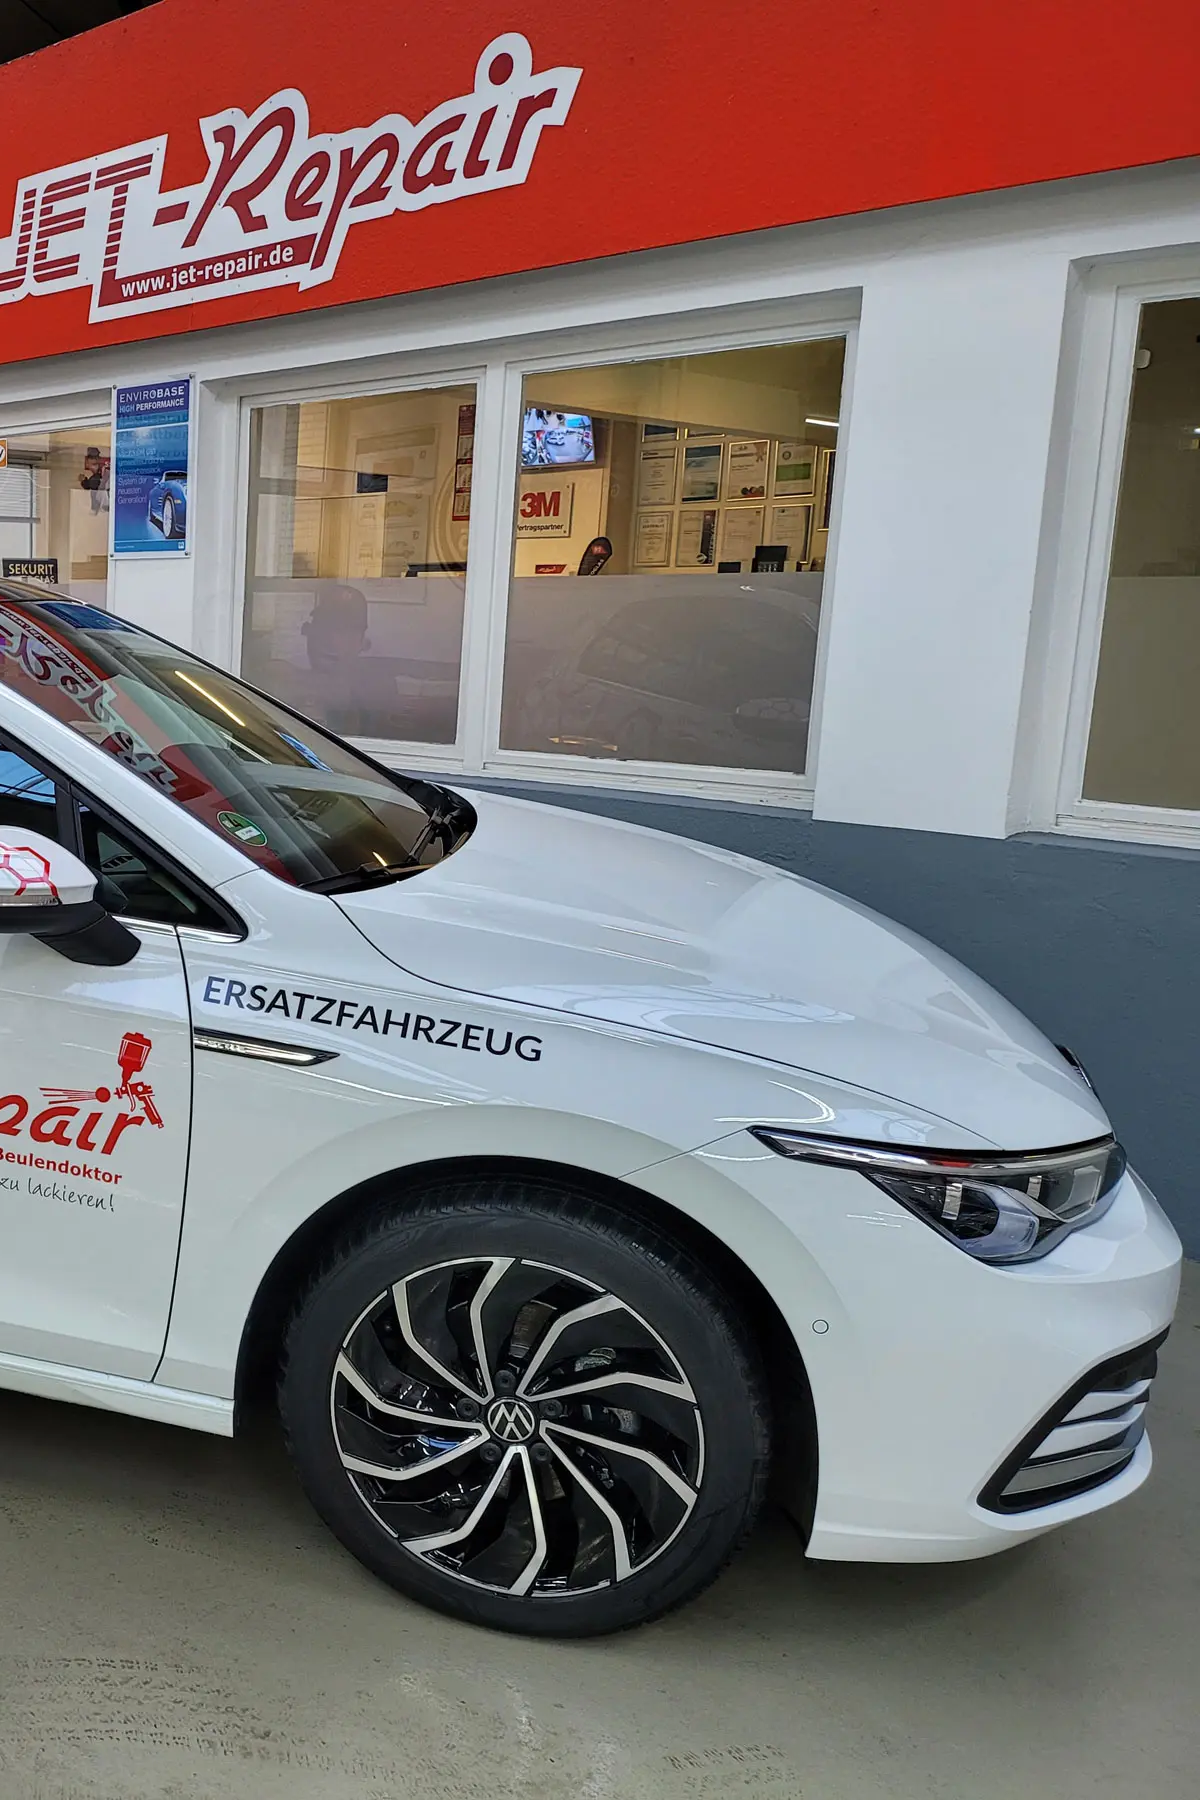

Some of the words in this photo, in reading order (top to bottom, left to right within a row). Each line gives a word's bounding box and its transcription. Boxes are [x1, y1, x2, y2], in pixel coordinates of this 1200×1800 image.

[121, 244, 294, 298] www.jet-repair.de
[119, 386, 185, 403] ENVIROBASE
[119, 404, 135, 413] HIGH
[135, 398, 185, 412] PERFORMANCE
[520, 491, 561, 518] 3M
[8, 563, 54, 575] SEKURIT
[202, 976, 544, 1062] ERSATZFAHRZEUG
[28, 1178, 115, 1212] lackieren!
